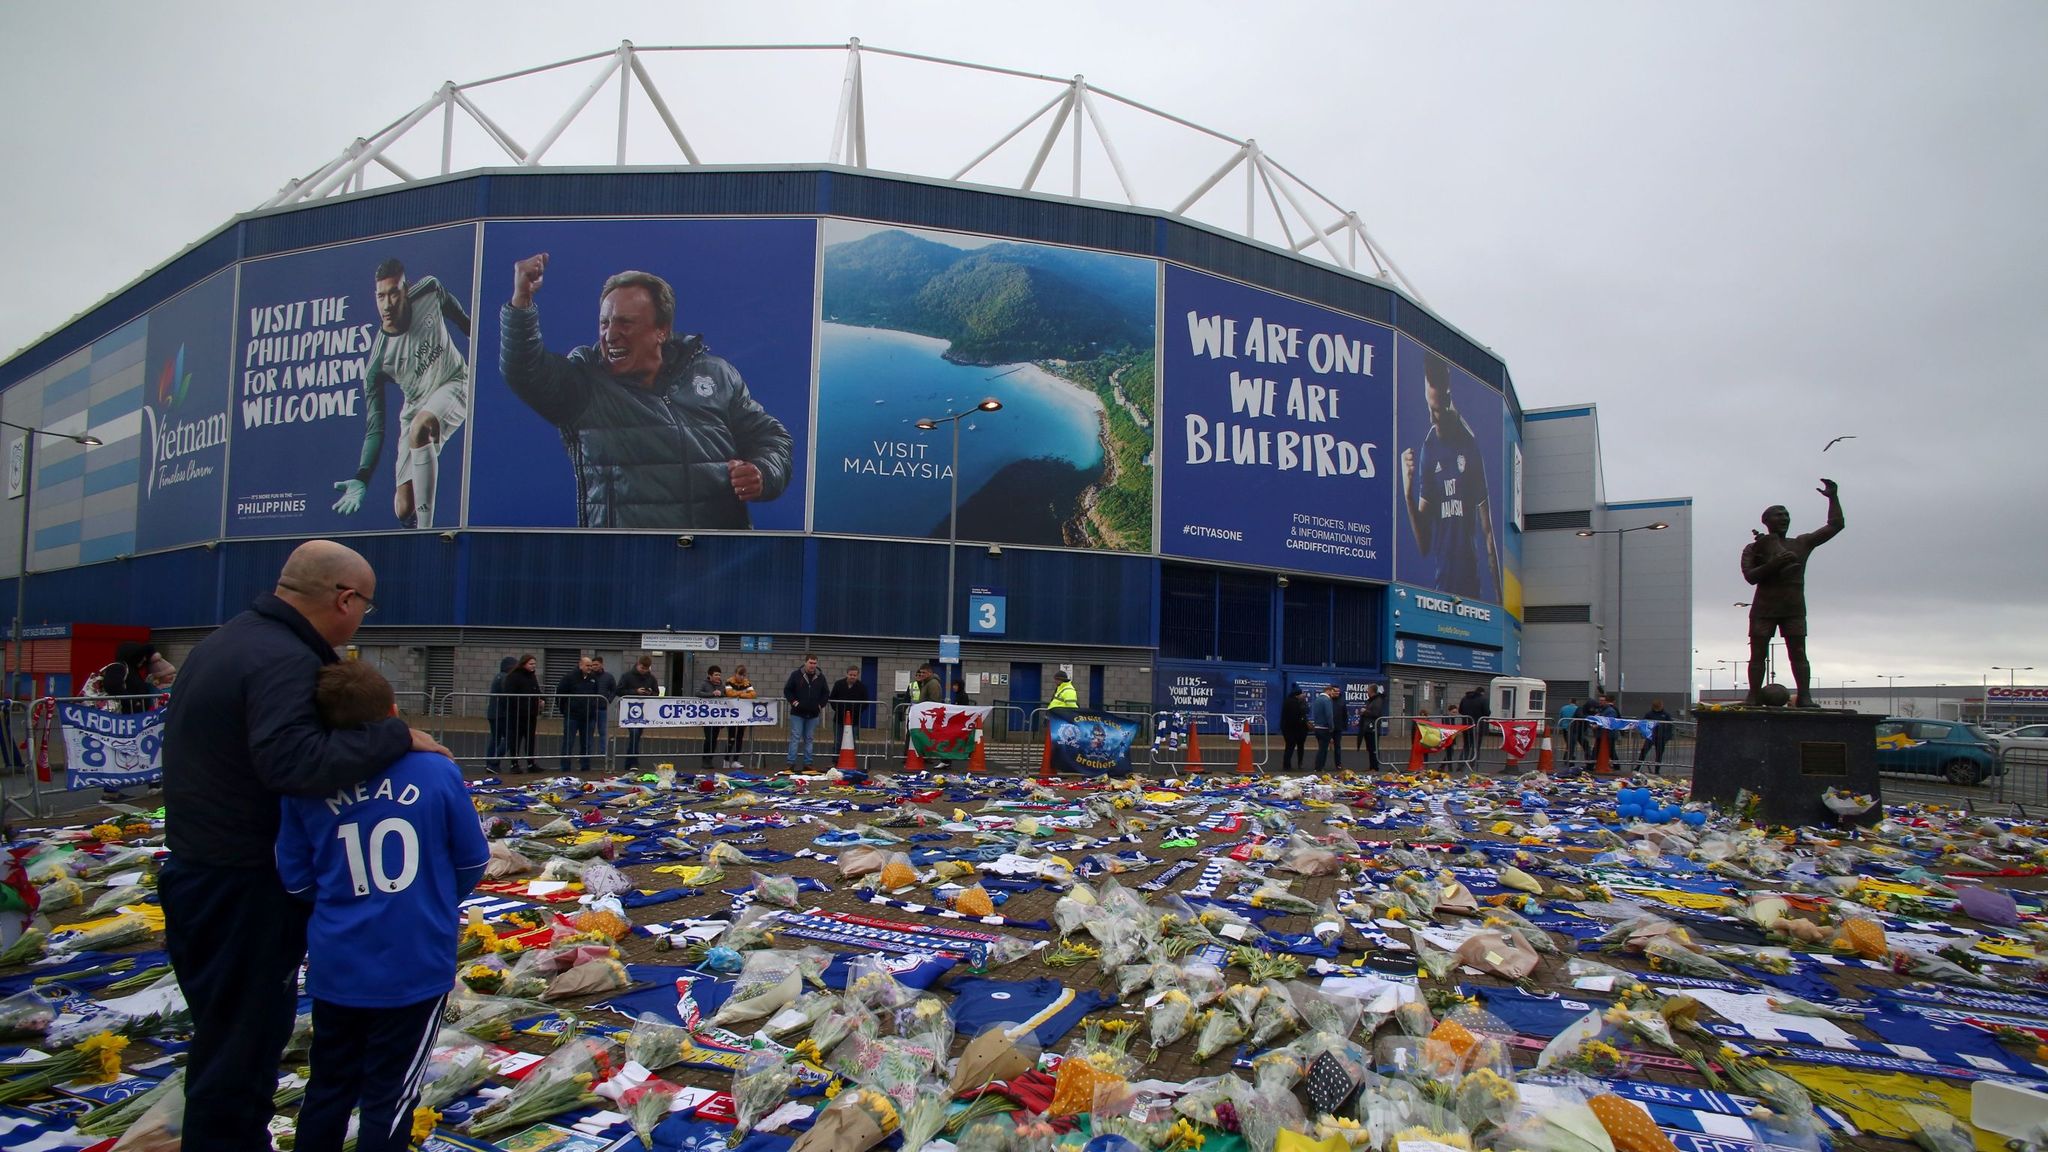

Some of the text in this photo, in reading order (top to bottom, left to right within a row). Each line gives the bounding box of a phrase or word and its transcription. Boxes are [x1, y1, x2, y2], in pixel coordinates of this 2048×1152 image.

[251, 296, 350, 338] VISIT THE
[245, 323, 373, 368] PHILIPPINES
[1187, 310, 1375, 377] WE ARE ONE
[243, 357, 367, 397] FOR A WARM
[242, 388, 360, 430] WELCOME
[1229, 371, 1340, 423] WE ARE
[142, 405, 227, 500] Vietnam
[873, 440, 929, 459] VISIT
[1184, 413, 1377, 479] BLUEBIRDS
[159, 459, 214, 489] Timeless Charm
[843, 457, 953, 480] MALAYSIA
[237, 499, 306, 515] PHILIPPINES
[1183, 525, 1243, 542] #CITYASONE
[1291, 526, 1373, 547] & INFORMATION VISIT
[1293, 513, 1310, 525] FOR
[1348, 522, 1371, 534] NEWS
[1286, 538, 1377, 560] CARDIFFCITYFC.CO.UK
[979, 603, 996, 629] 3
[1415, 595, 1491, 621] TICKET OFFICE
[65, 706, 137, 735] CARDIFF
[658, 704, 740, 719] CF38ers
[1075, 753, 1116, 769] brothers
[324, 778, 420, 816] MEAD
[337, 817, 420, 896] 10
[1634, 1086, 1692, 1102] CITY
